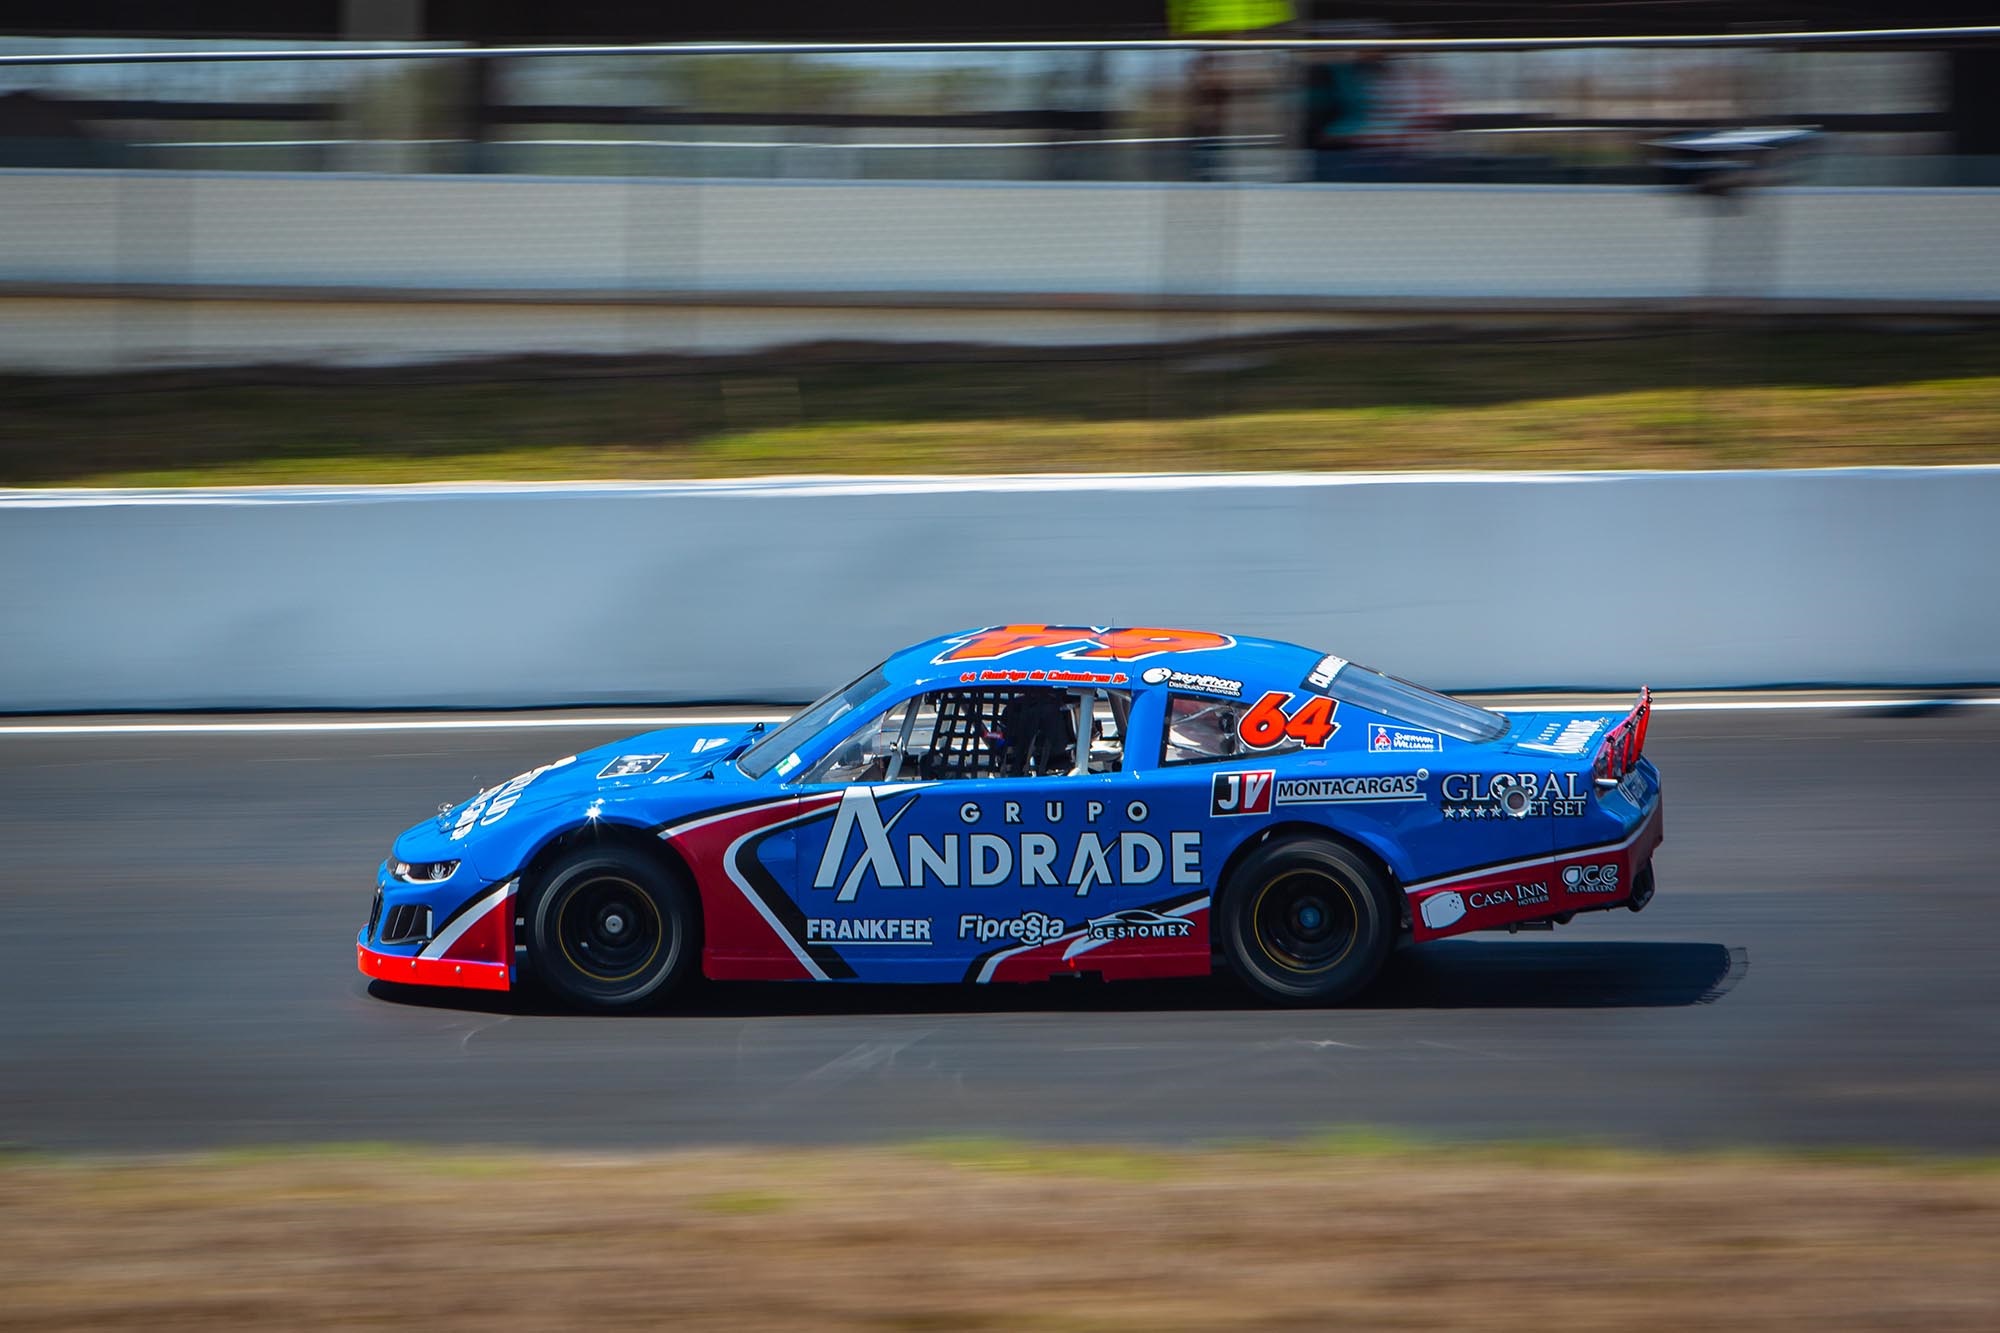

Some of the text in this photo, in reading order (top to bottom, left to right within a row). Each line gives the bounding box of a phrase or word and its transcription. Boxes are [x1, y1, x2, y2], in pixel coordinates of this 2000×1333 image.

[960, 672, 977, 683] 64
[1238, 691, 1341, 750] 64
[1394, 732, 1434, 744] SHERWIN
[1217, 774, 1417, 810] JV MONTACARGAS
[1442, 773, 1587, 801] GLOBAL
[960, 801, 1148, 823] GRUPO
[1553, 801, 1586, 816] SET
[813, 786, 1201, 901] ANDRADE
[1469, 892, 1513, 909] CASA
[1516, 881, 1548, 900] INN
[807, 919, 931, 940] FRANKFER
[1094, 924, 1189, 940] GESTOMEX
